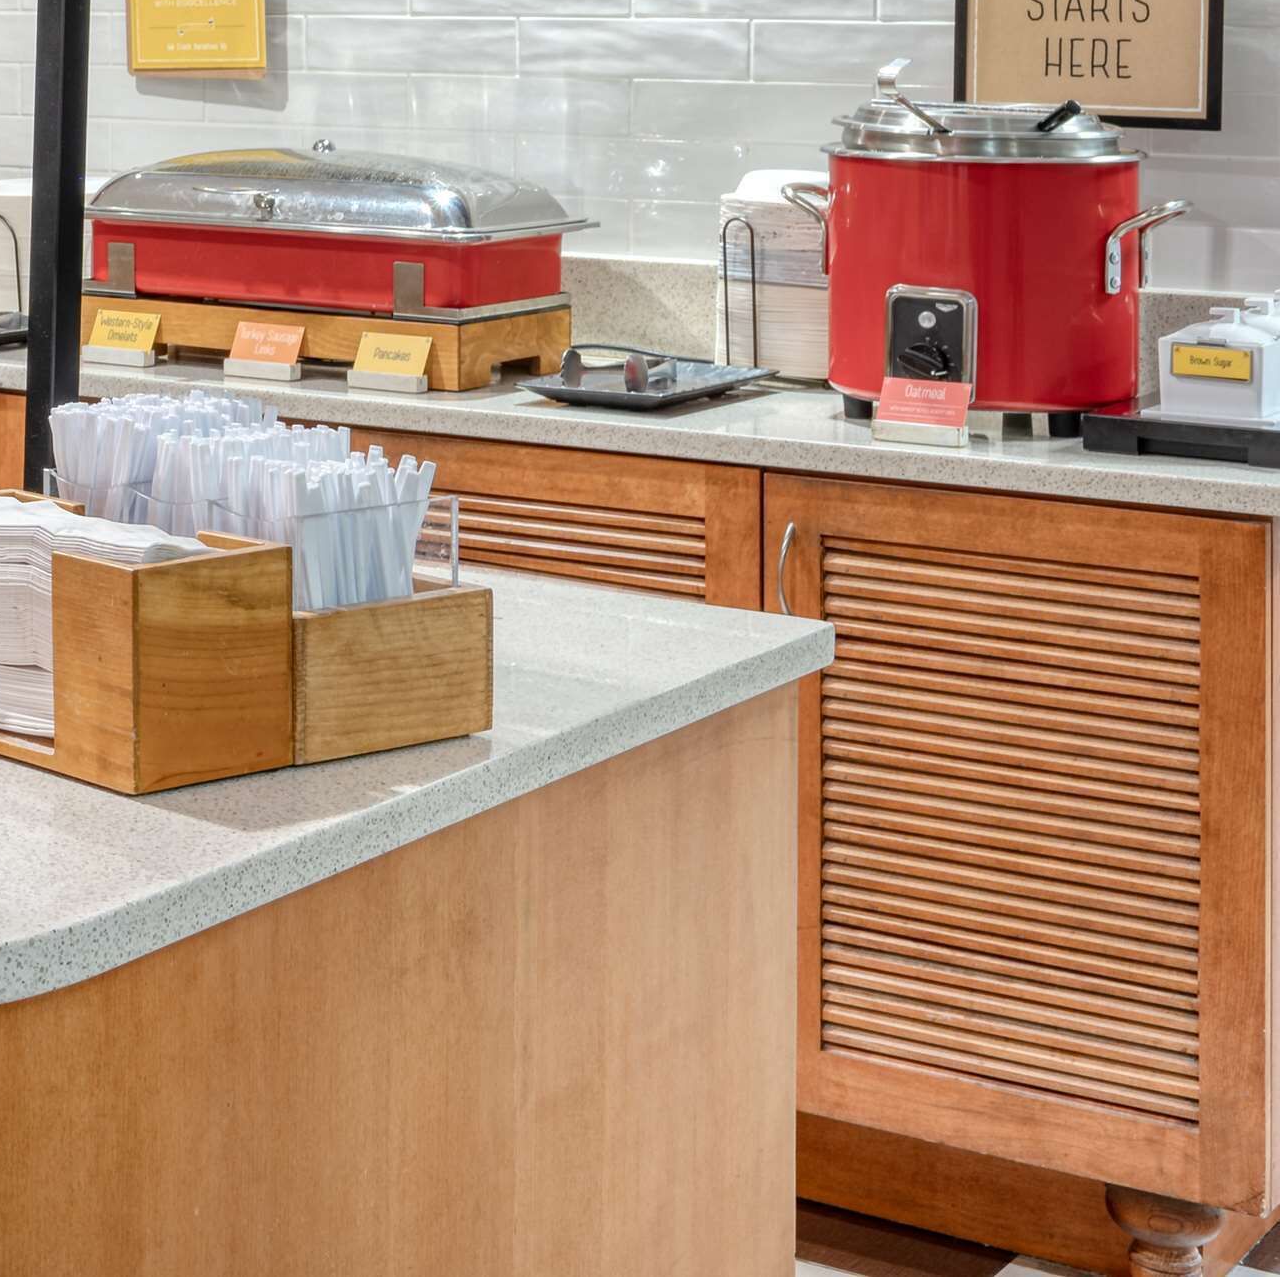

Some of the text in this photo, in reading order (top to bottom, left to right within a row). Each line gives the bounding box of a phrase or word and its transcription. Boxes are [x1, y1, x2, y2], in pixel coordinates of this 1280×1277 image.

[1044, 37, 1133, 80] HERE
[1189, 355, 1232, 369] Brown Sugar
[905, 383, 946, 400] Oatmeal
